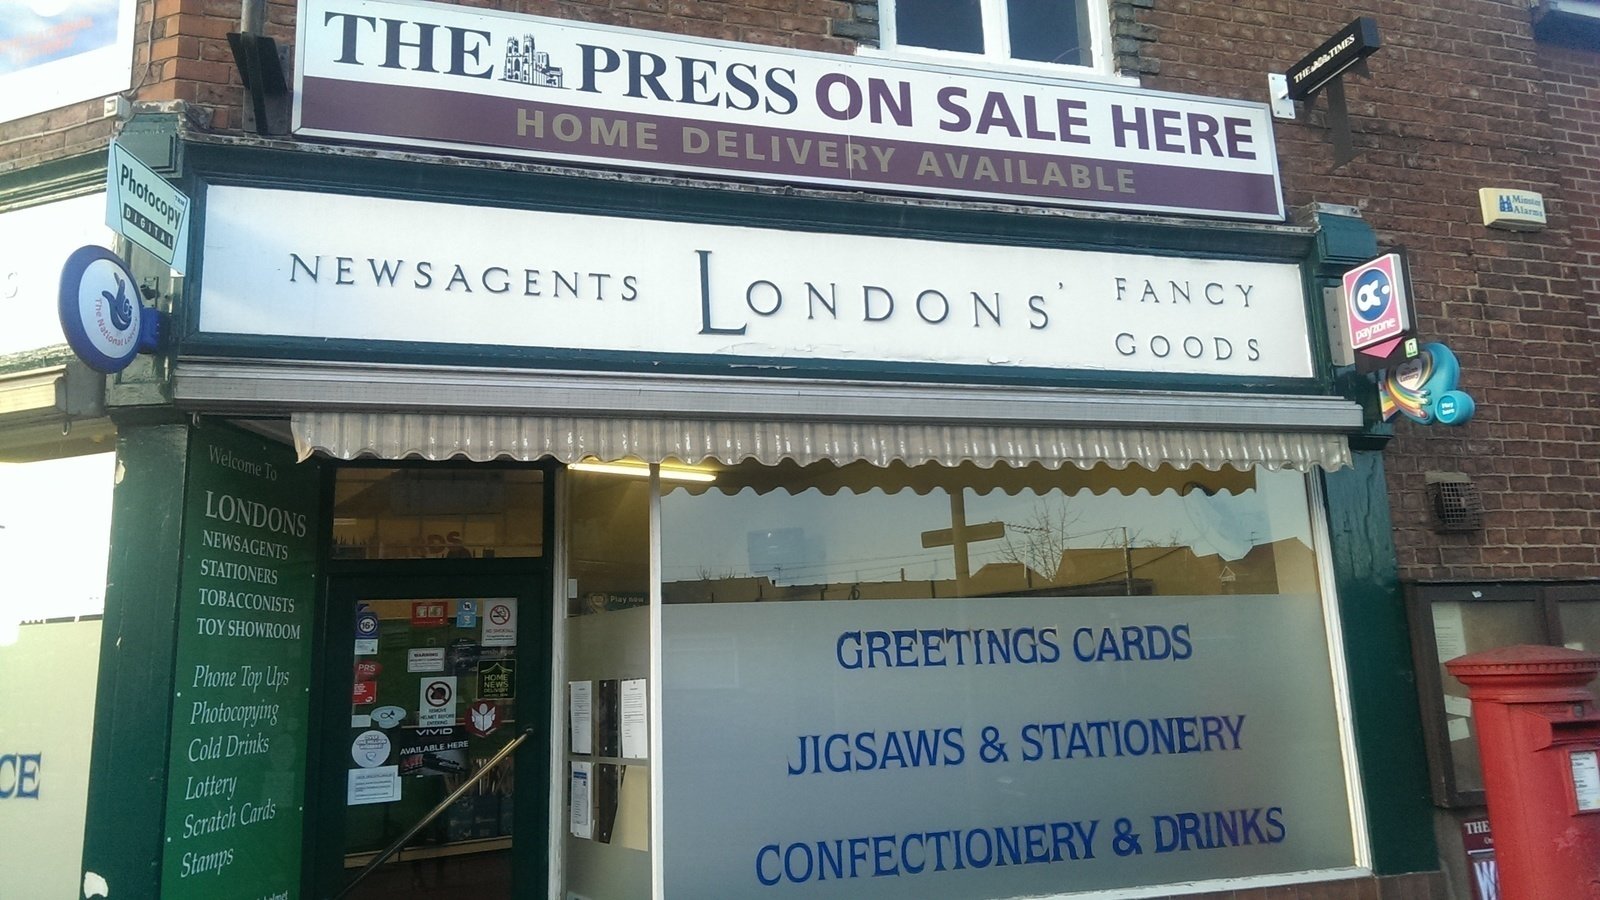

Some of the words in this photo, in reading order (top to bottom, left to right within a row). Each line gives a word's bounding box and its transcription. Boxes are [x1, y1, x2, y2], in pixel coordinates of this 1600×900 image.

[1293, 65, 1311, 83] THE
[1328, 33, 1355, 58] TIMES
[324, 11, 495, 80] THE
[575, 42, 798, 115] PRESS
[815, 72, 913, 128] ON
[939, 87, 1091, 145] SALE
[1110, 104, 1257, 160] HERE
[516, 108, 658, 151] HOME
[682, 126, 896, 173] DELIVERY
[916, 150, 1137, 193] AVAILABLE
[120, 163, 181, 230] Photocopy
[1514, 205, 1543, 217] Alarms
[125, 206, 173, 247] DIGITAL
[289, 252, 638, 301] NEWSAGENTS
[1113, 277, 1254, 309] FANCY
[97, 318, 124, 346] National
[1355, 318, 1396, 344] payzone
[1114, 332, 1260, 362] GOODS
[208, 444, 262, 477] Welcome
[264, 462, 278, 482] To
[205, 490, 307, 538] LONDONS
[202, 529, 289, 561] NEWSAGENTS
[200, 558, 278, 585] STATIONERS
[198, 587, 295, 614] TOBACCONISTS
[196, 617, 226, 636] TOY
[227, 619, 301, 640] SHOWROOM
[836, 625, 1060, 670] GREETINGS
[1073, 622, 1193, 662] CARDS
[192, 664, 236, 688] Phone
[241, 665, 262, 693] Top
[266, 665, 290, 692] Ups
[358, 663, 376, 672] PRS
[190, 698, 280, 728] Photocopying
[188, 735, 223, 763] Cold
[225, 732, 270, 758] Drinks
[415, 728, 453, 736] VIVID
[787, 726, 965, 776] JIGSAWS
[978, 725, 1009, 763] &
[1020, 714, 1247, 762] STATIONERY
[399, 743, 445, 756] AVAILABLE
[447, 740, 469, 749] HERE
[185, 775, 237, 801] Lottery
[183, 805, 236, 839] Scratch
[240, 798, 276, 826] Cards
[1464, 820, 1491, 835] THE
[755, 818, 1101, 887] CONFECTIONERY
[1112, 816, 1143, 858] &
[1151, 806, 1288, 854] DRINKS
[180, 847, 234, 878] Stamps
